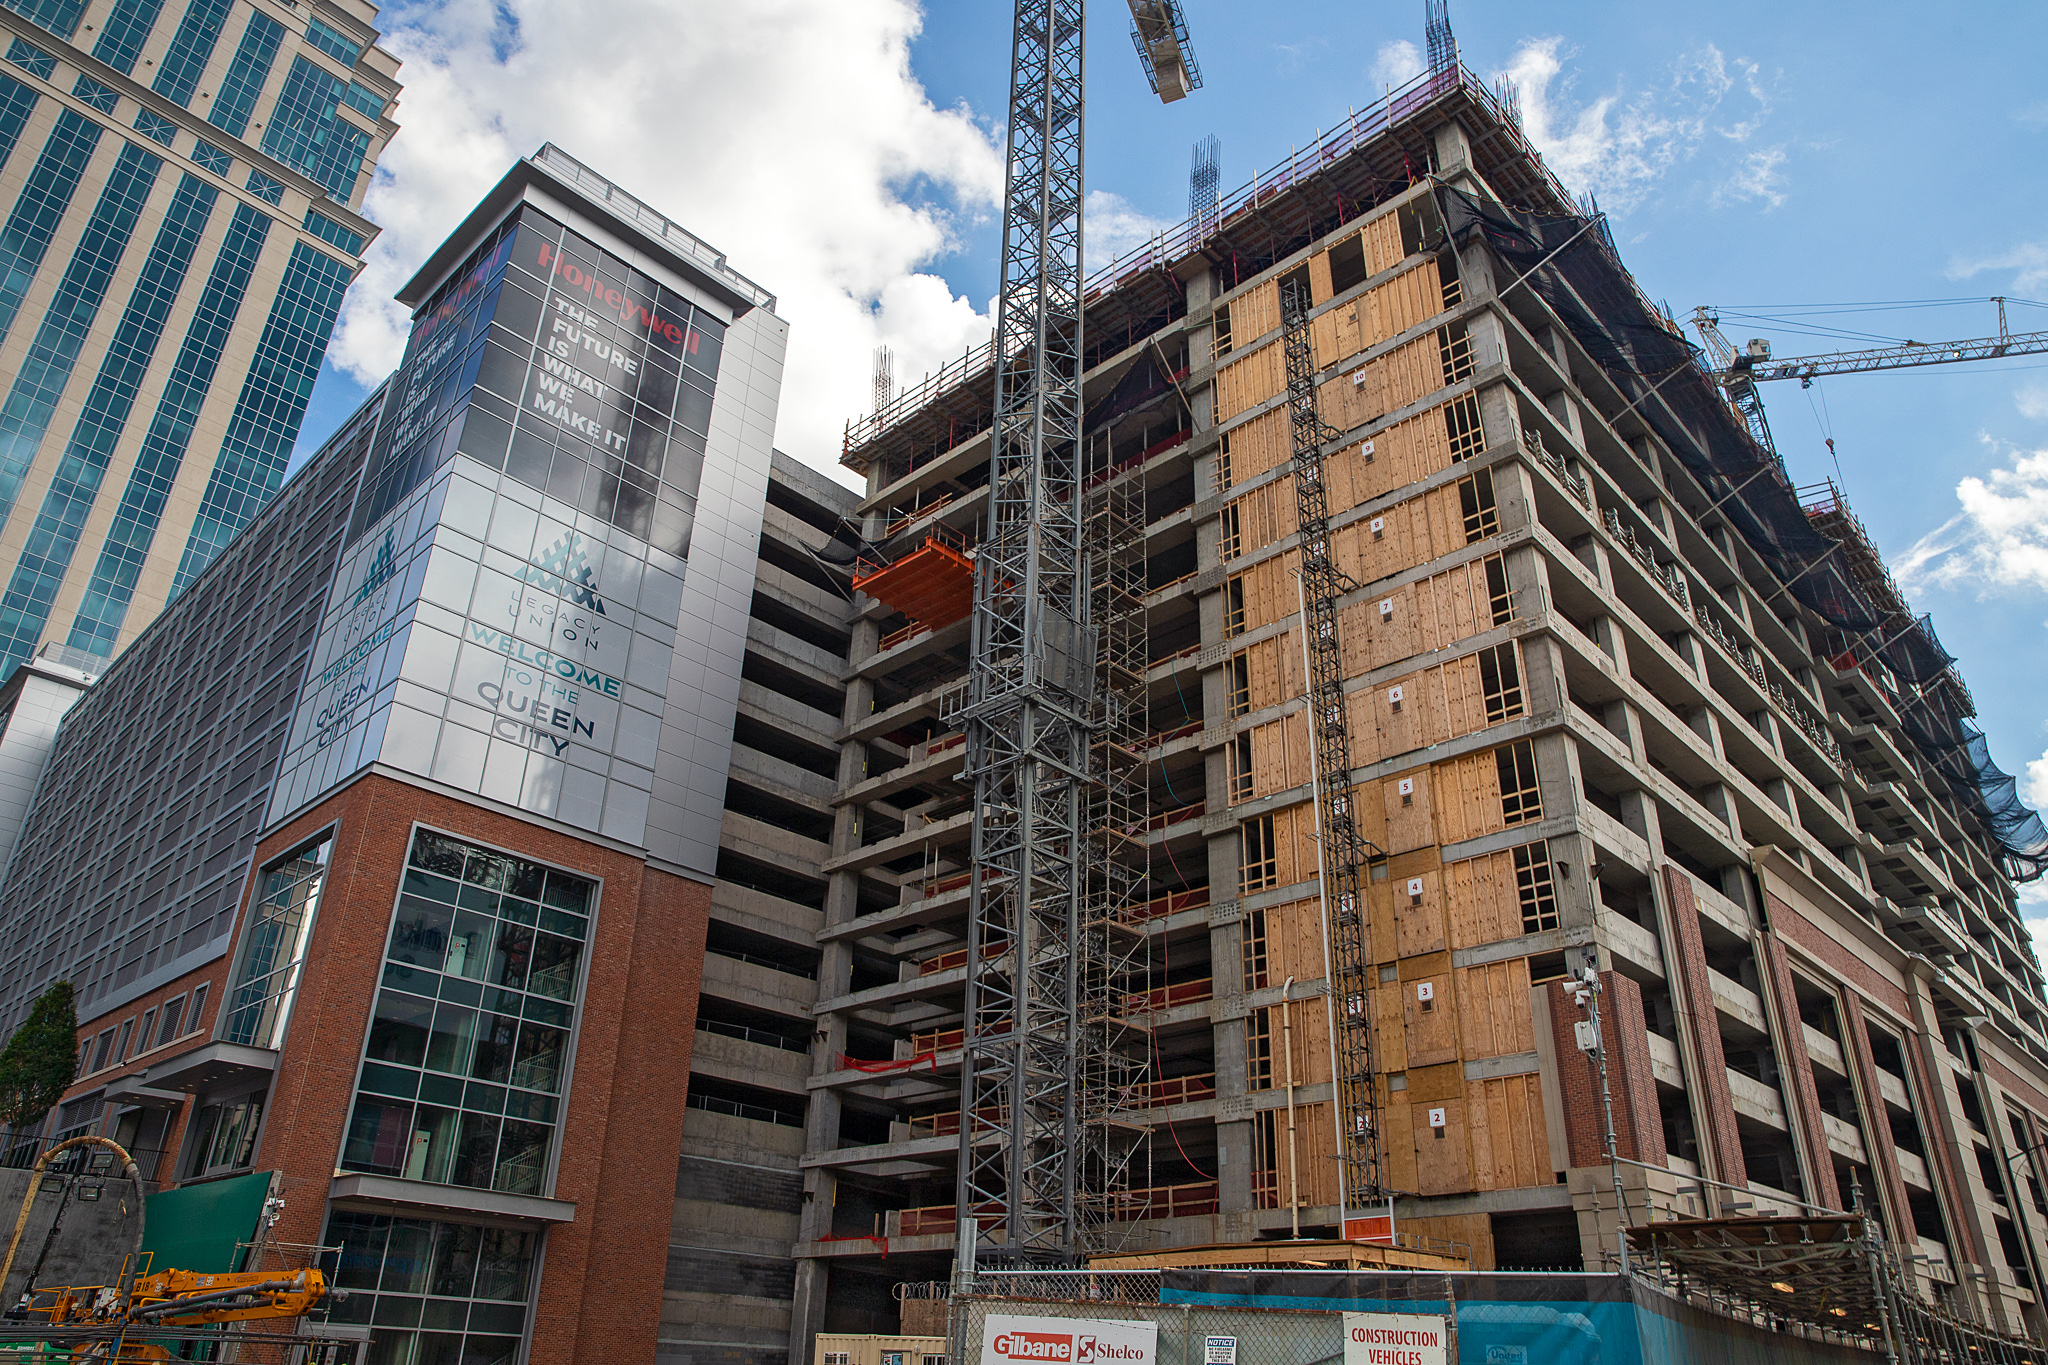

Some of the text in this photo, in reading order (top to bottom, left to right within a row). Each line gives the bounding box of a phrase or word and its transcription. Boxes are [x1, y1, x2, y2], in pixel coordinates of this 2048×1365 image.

[537, 242, 700, 355] Honeywell
[555, 297, 598, 330] THE
[410, 332, 457, 387] FUTURE
[548, 336, 569, 358] IS
[552, 318, 638, 376] FUTURE
[538, 372, 576, 404] WE
[543, 353, 608, 398] WHAT
[389, 404, 438, 460] MAKE IT
[533, 392, 626, 450] MAKE IT
[344, 601, 388, 642] UNON
[508, 604, 598, 651] UNION
[511, 590, 600, 634] LEGACY
[322, 620, 394, 686] WELCOME
[470, 622, 620, 698] WELCOME
[316, 676, 371, 728] QUEEN
[505, 665, 581, 704] TO THE
[318, 715, 352, 748] CITY
[478, 682, 595, 740] QUEEN
[494, 718, 570, 756] CITY
[1434, 1114, 1440, 1122] 2
[993, 1334, 1070, 1359] Gilbane
[1096, 1342, 1144, 1360] Shelco
[1351, 1328, 1438, 1348] CONSTRUCTION
[1368, 1349, 1422, 1365] VEHICLES
